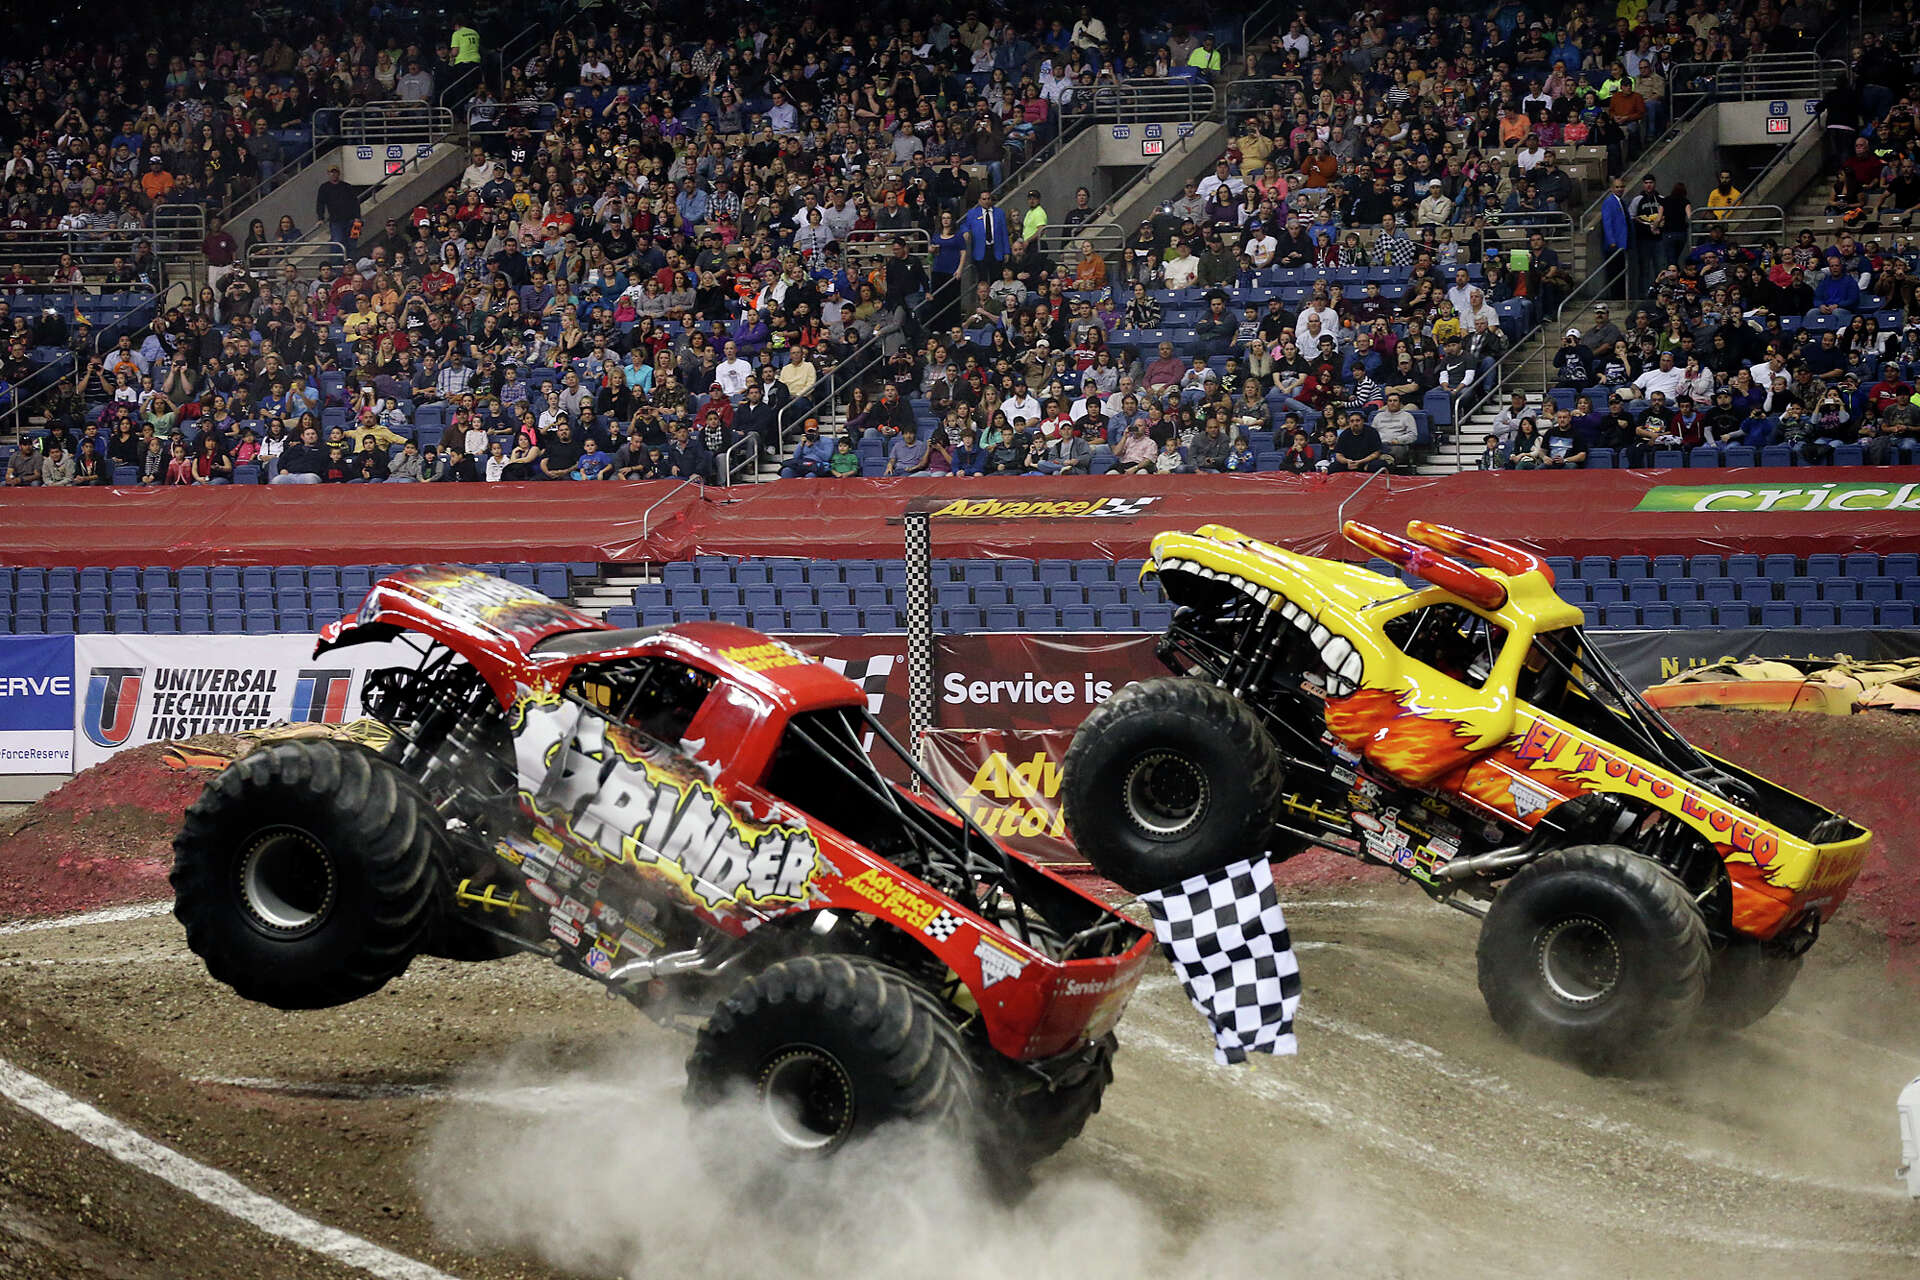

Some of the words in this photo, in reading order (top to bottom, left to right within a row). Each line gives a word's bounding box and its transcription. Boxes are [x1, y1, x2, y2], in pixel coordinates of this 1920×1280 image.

[1770, 119, 1788, 132] EXIT
[1146, 142, 1160, 153] EXIT
[154, 669, 277, 692] UNIVERSAL
[943, 672, 1075, 704] Service
[1084, 673, 1113, 703] is
[151, 692, 272, 716] TECHNICAL
[512, 697, 818, 908] GRINDER
[845, 876, 885, 904] Auto
[881, 896, 924, 929] Parts
[857, 868, 935, 915] Advance
